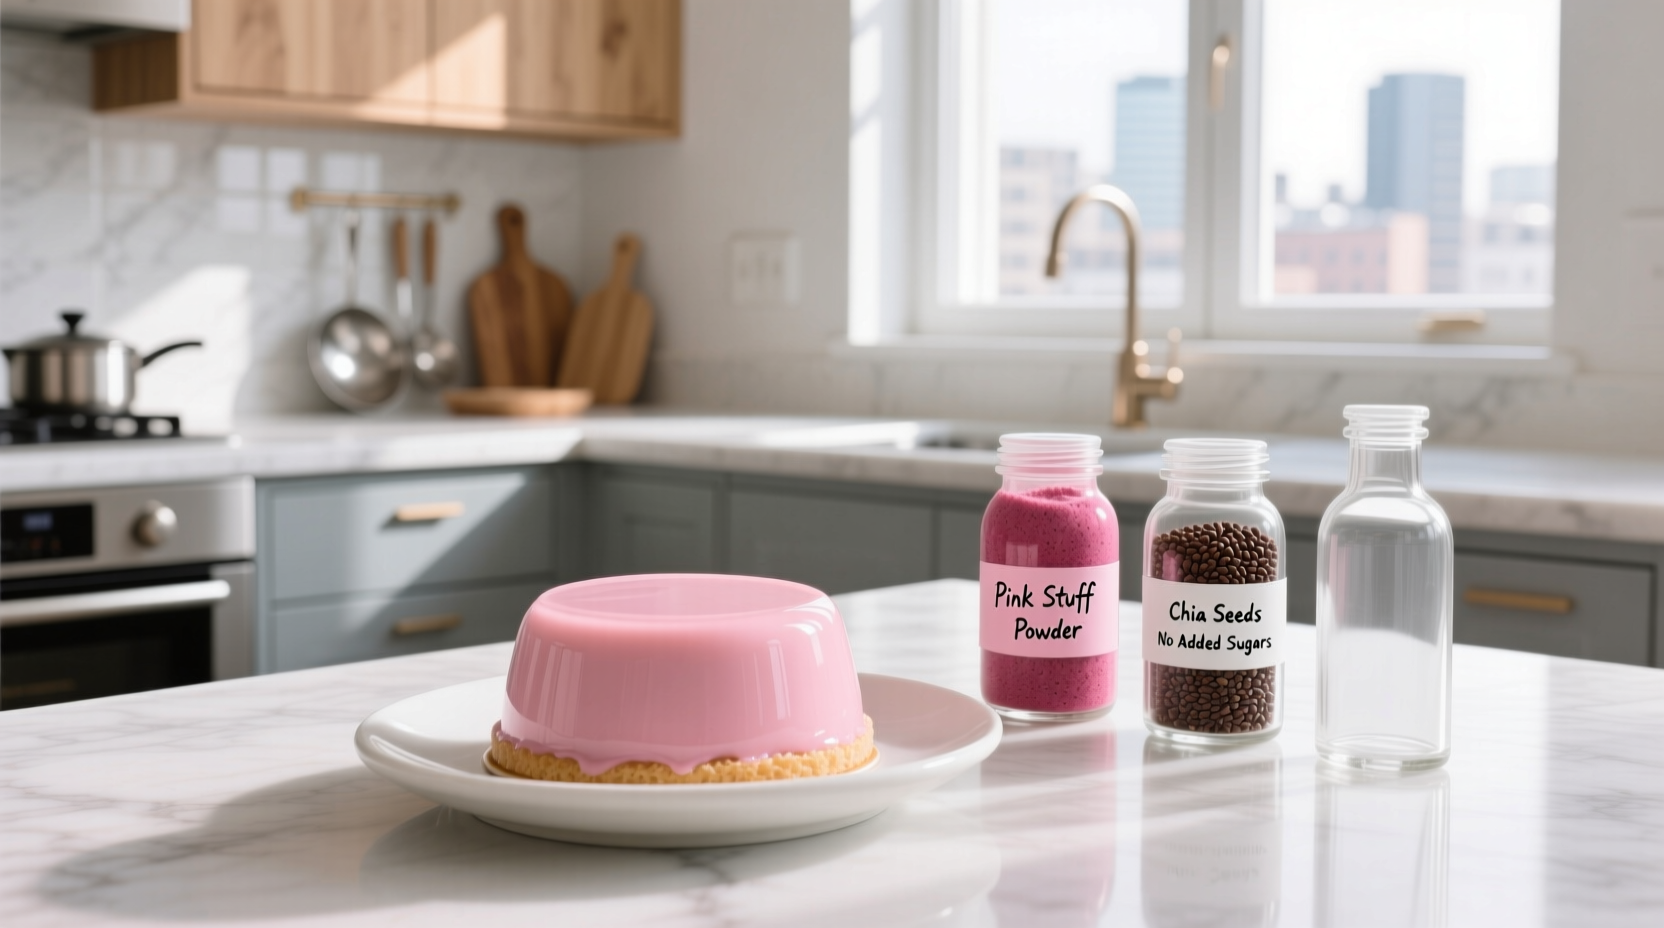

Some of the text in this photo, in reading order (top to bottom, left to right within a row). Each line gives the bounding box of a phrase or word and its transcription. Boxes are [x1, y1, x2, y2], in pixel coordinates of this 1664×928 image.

[994, 580, 1097, 615] Pink Stuff
[1169, 600, 1262, 624] Chia Seeds
[1014, 617, 1083, 641] Powder
[1157, 631, 1272, 656] No Added Sugars
